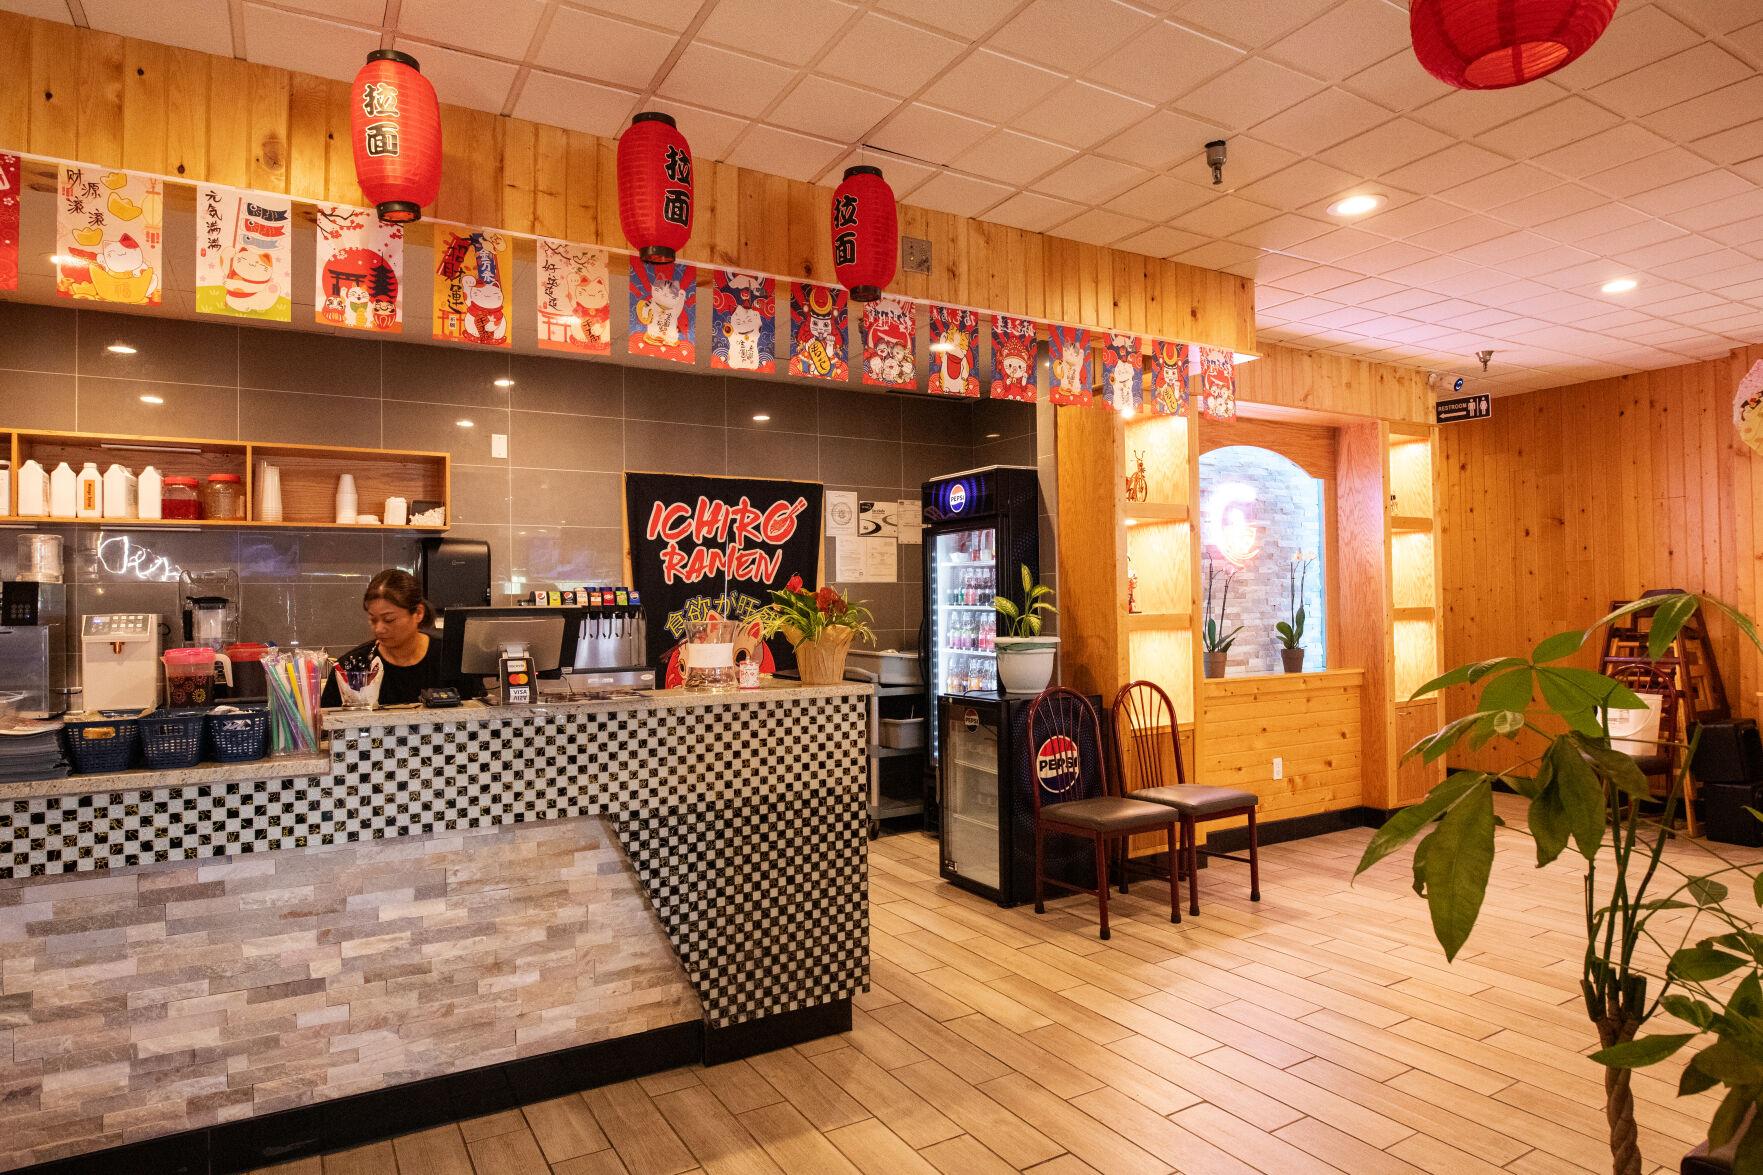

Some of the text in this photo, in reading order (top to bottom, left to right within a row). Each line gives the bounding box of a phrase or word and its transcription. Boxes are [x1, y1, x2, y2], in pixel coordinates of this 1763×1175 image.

[363, 83, 400, 157] 拉面
[664, 145, 692, 228] 拉面
[833, 195, 858, 267] 拉面
[1438, 402, 1467, 411] RESTROOM
[647, 496, 807, 546] ICHIRO
[951, 494, 964, 502] PEPSI
[660, 542, 782, 585] RAMEN
[1039, 756, 1077, 772] PEPSI
